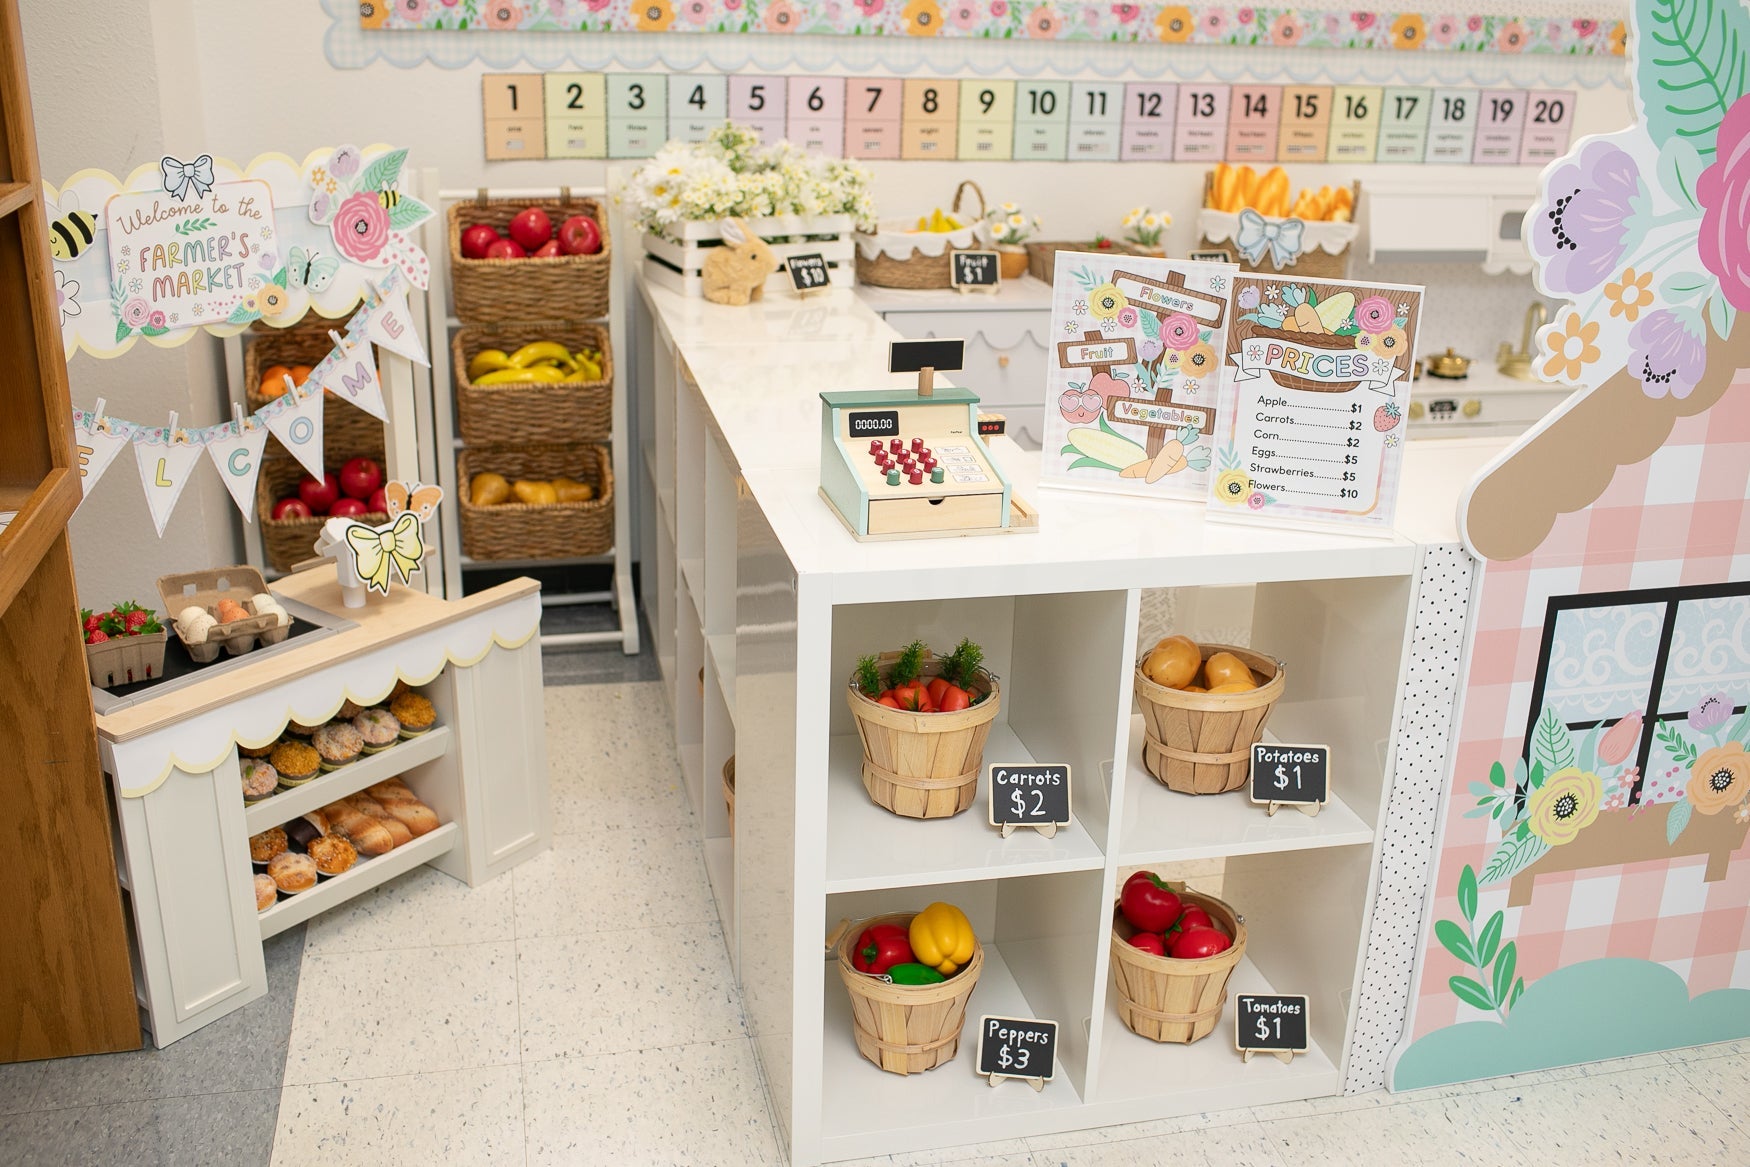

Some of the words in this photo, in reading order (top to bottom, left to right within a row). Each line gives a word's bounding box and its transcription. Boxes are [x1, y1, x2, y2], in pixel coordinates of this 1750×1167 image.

[507, 84, 518, 111] 1
[566, 83, 584, 109] 2
[628, 84, 645, 110] 3
[688, 84, 706, 110] 4
[748, 85, 765, 111] 5
[808, 86, 824, 112] 6
[865, 87, 882, 113] 7
[922, 88, 938, 113] 8
[979, 89, 995, 114] 9
[1028, 90, 1057, 115] 10
[1086, 91, 1107, 116] 11
[1136, 92, 1162, 117] 12
[1190, 92, 1215, 118] 13
[1243, 93, 1268, 119] 14
[1294, 94, 1319, 119] 15
[1345, 95, 1369, 119] 16
[1394, 96, 1419, 120] 17
[1443, 97, 1466, 121] 18
[1491, 98, 1514, 122] 19
[1533, 100, 1564, 124] 20
[116, 200, 204, 235] Welcome
[212, 194, 229, 214] to
[237, 196, 262, 220] the
[139, 231, 249, 272] FARMER'S
[959, 255, 988, 268] Fruit
[152, 262, 245, 302] MARKET
[800, 267, 825, 287] $10
[963, 266, 983, 284] $1
[1139, 286, 1194, 311] Flowers
[1080, 346, 1114, 360] Fruit
[1265, 343, 1369, 378] PRICES
[1121, 402, 1200, 424] Vegetables
[1350, 403, 1362, 414] $1
[855, 418, 893, 430] 0000.00
[1348, 420, 1362, 431] $2
[1346, 437, 1360, 448] $2
[1344, 454, 1358, 465] $5
[1342, 471, 1356, 482] $5
[1340, 488, 1358, 499] $10
[1256, 747, 1320, 763] Potatoes
[997, 769, 1061, 786] Carrots
[1273, 764, 1302, 791] $1
[1010, 787, 1046, 819] $2
[1242, 998, 1301, 1015] Tomatoes
[989, 1020, 1049, 1048] Peppers
[1254, 1014, 1281, 1041] $1
[997, 1043, 1030, 1069] $3
